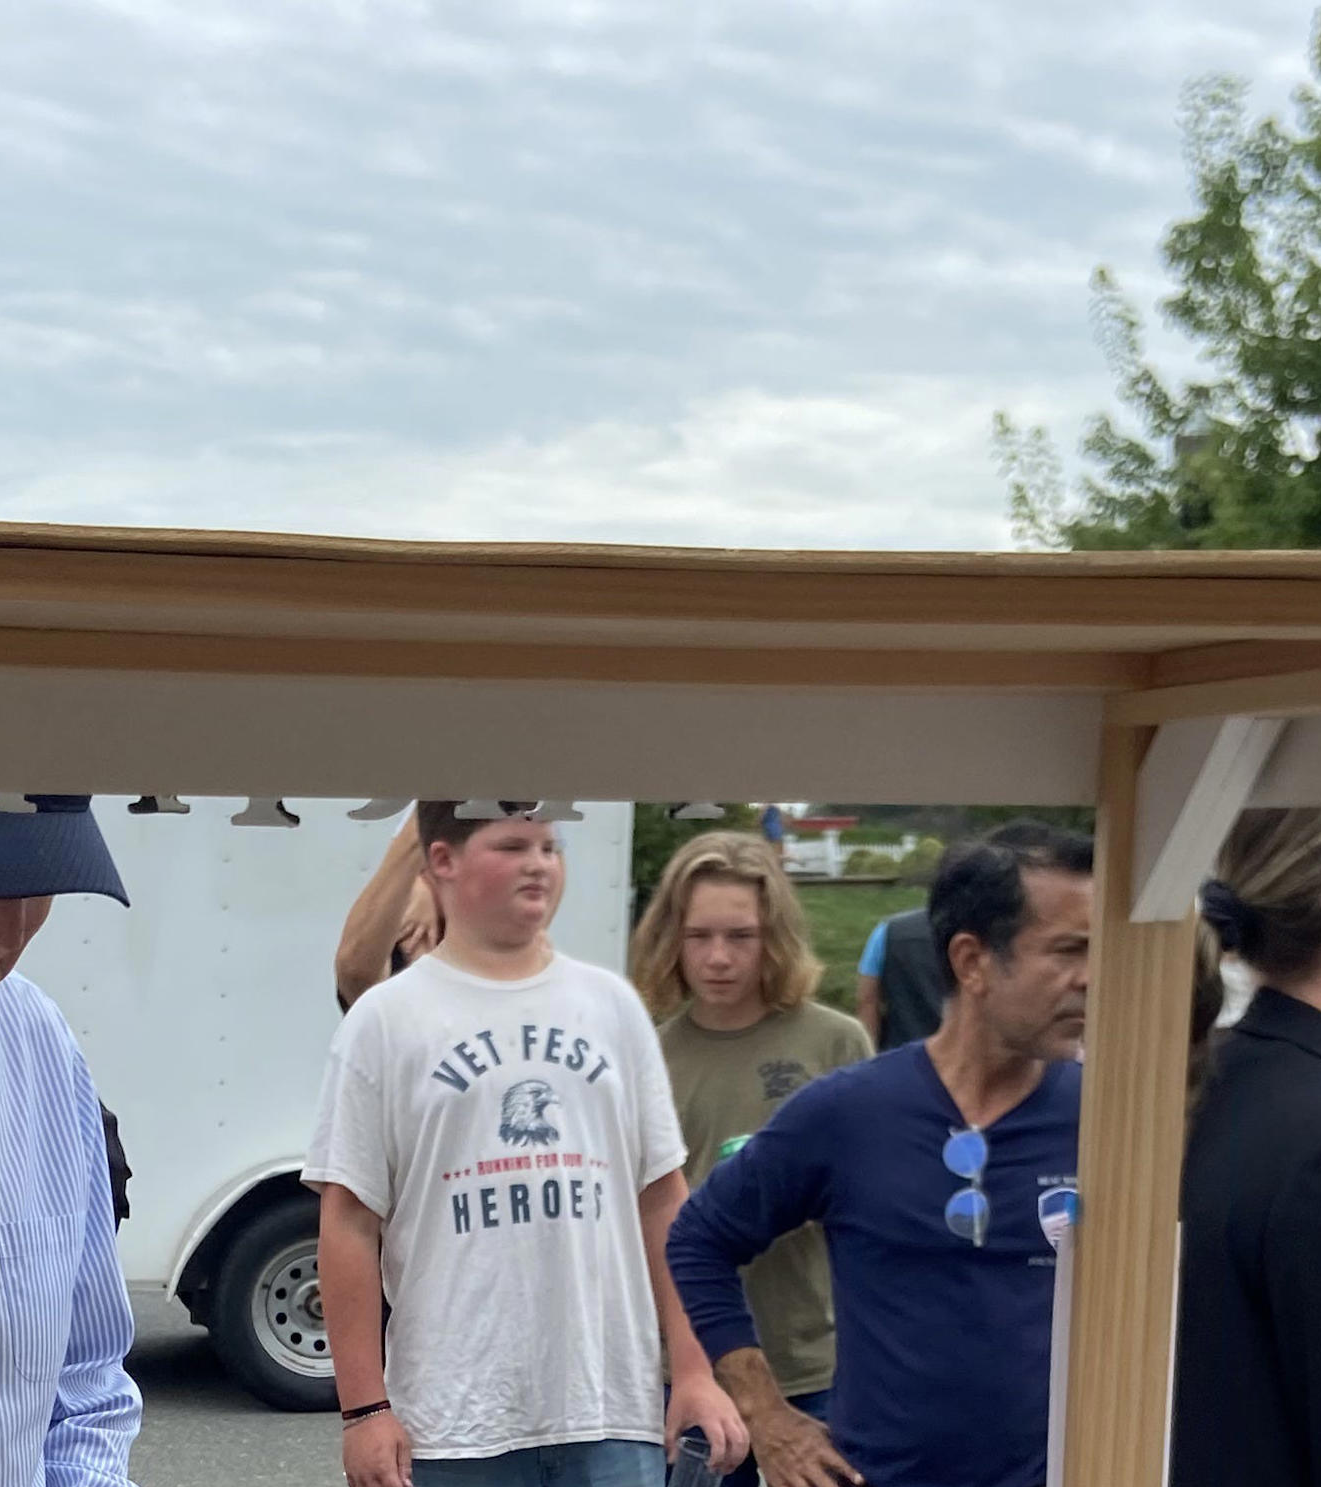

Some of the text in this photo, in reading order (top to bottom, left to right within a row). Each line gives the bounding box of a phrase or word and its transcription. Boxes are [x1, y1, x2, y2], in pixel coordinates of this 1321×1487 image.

[431, 1025, 609, 1093] VET FEST
[478, 1156, 532, 1175] RUNNING
[535, 1153, 559, 1168] FOR
